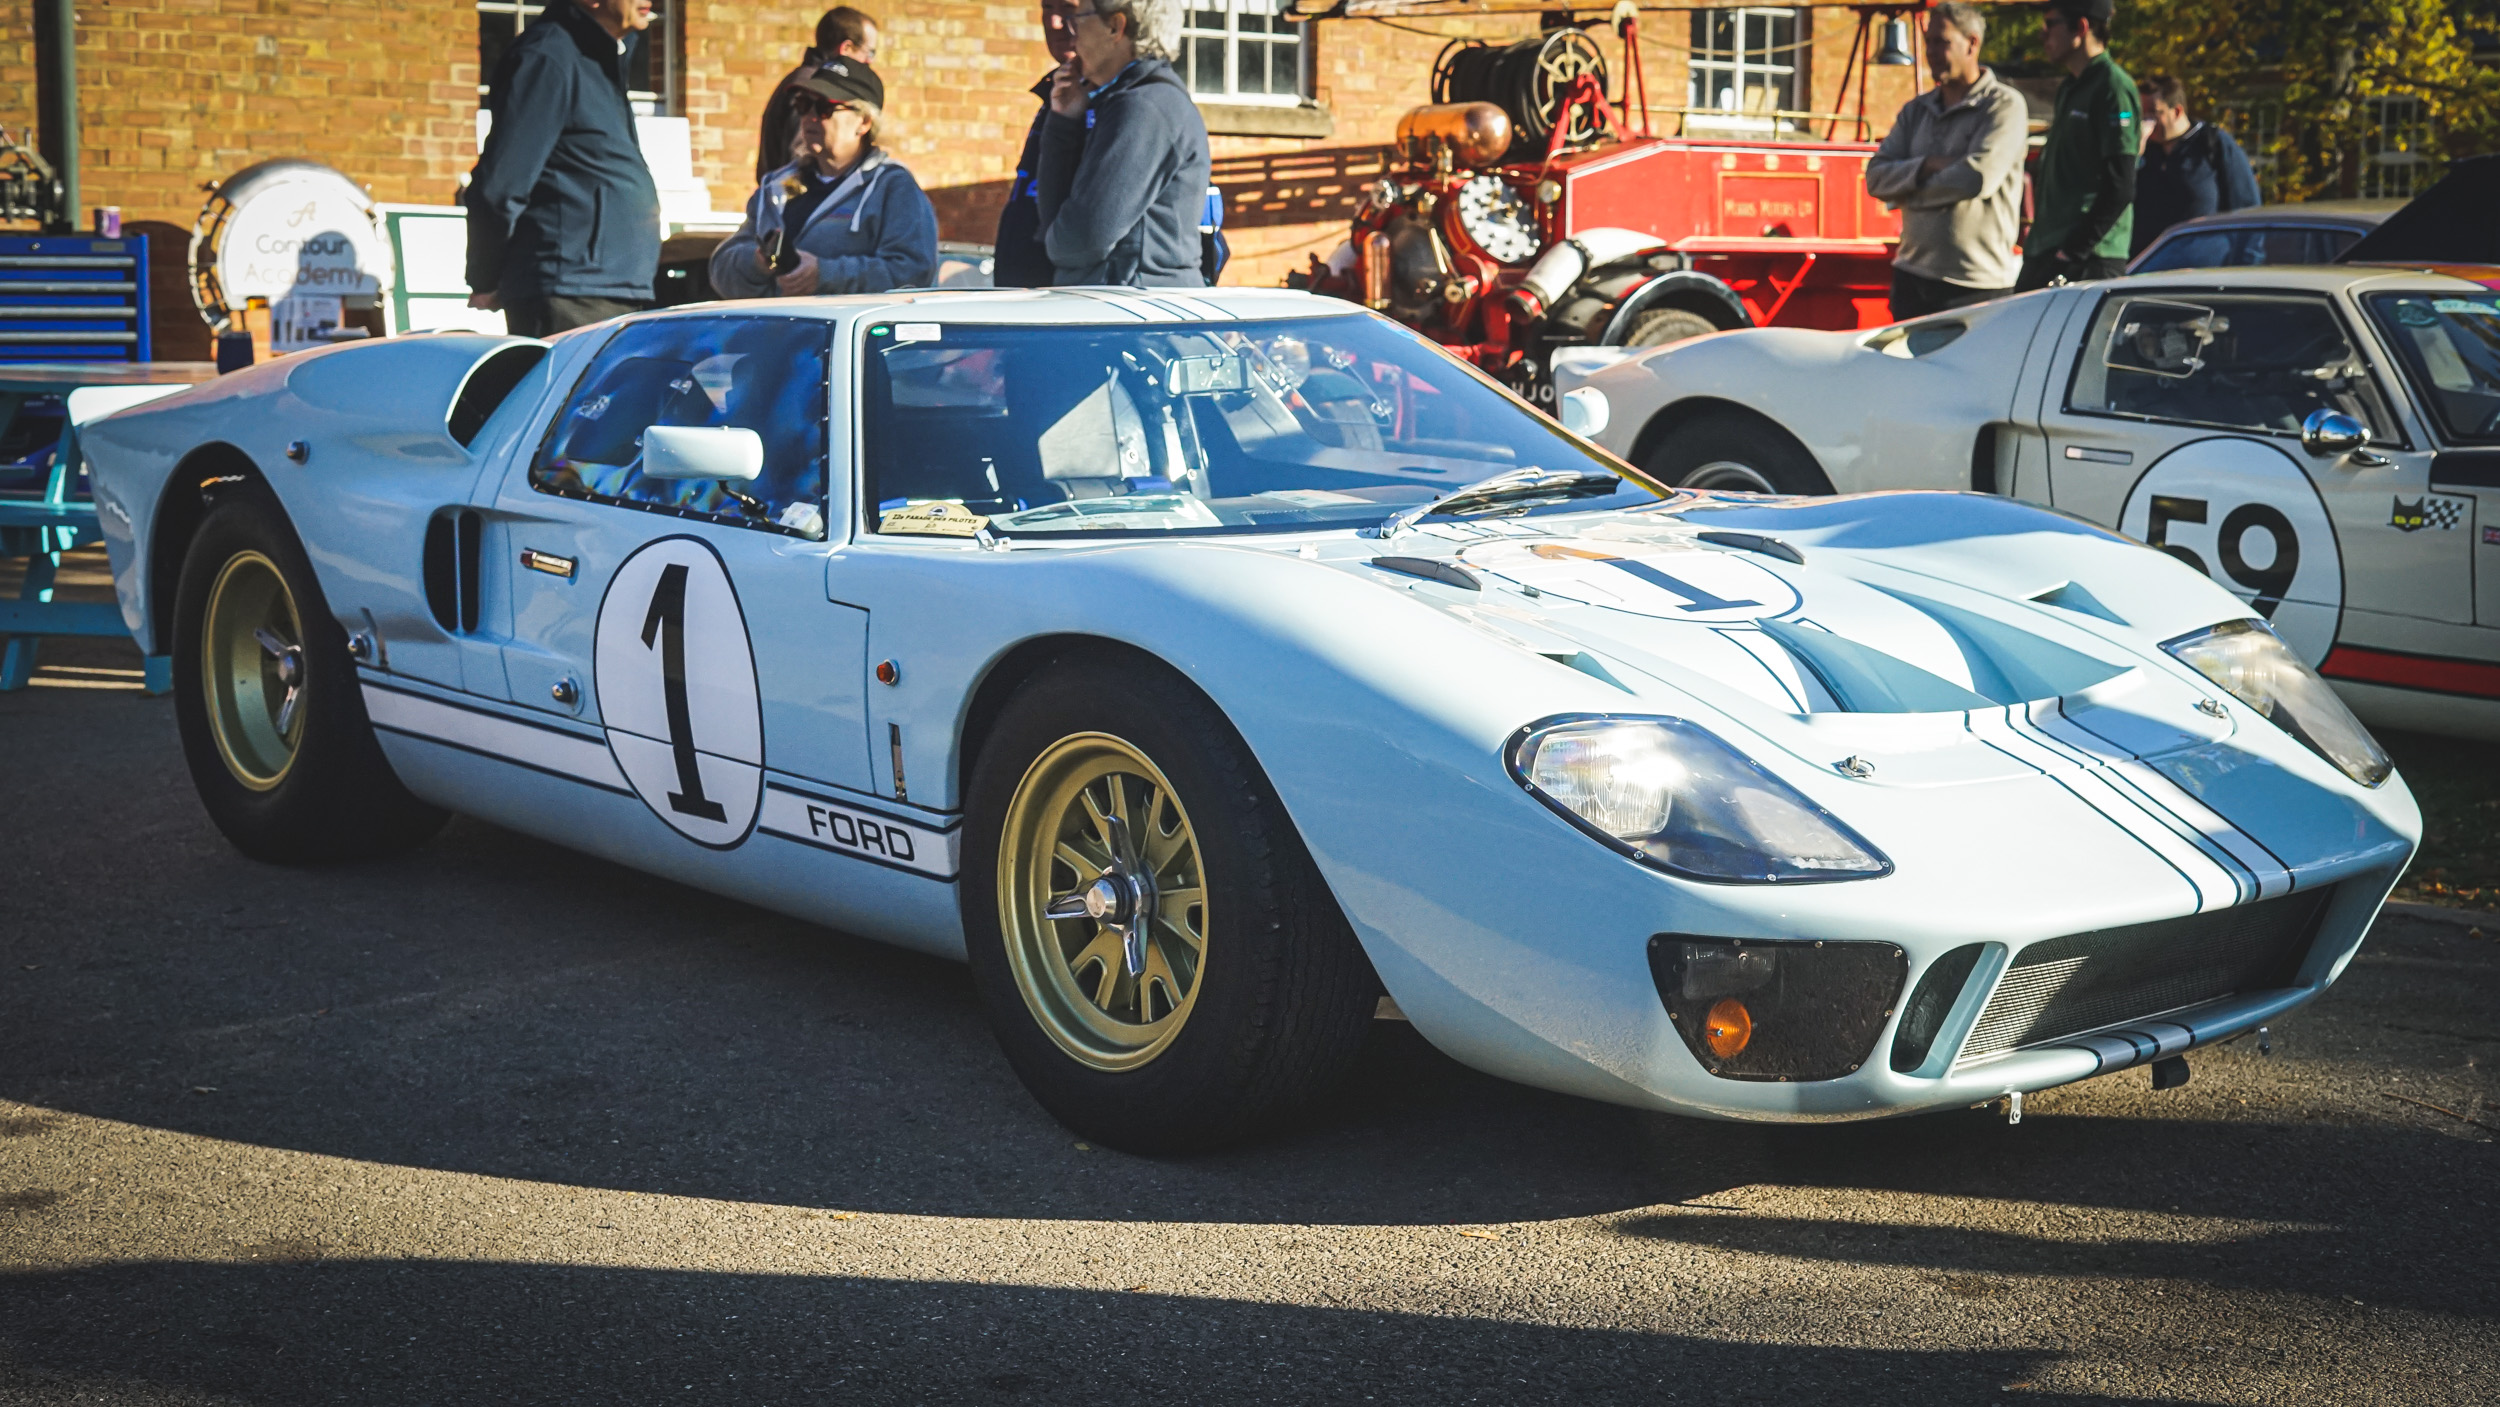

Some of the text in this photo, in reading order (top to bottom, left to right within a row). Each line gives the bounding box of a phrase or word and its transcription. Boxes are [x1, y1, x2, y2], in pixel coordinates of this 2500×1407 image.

[256, 233, 350, 255] Contour
[244, 262, 365, 289] Academy
[948, 516, 978, 524] PILOTES
[1522, 543, 1766, 613] 1
[2146, 494, 2300, 621] 59
[641, 563, 728, 823] 1
[806, 804, 915, 862] FORD
